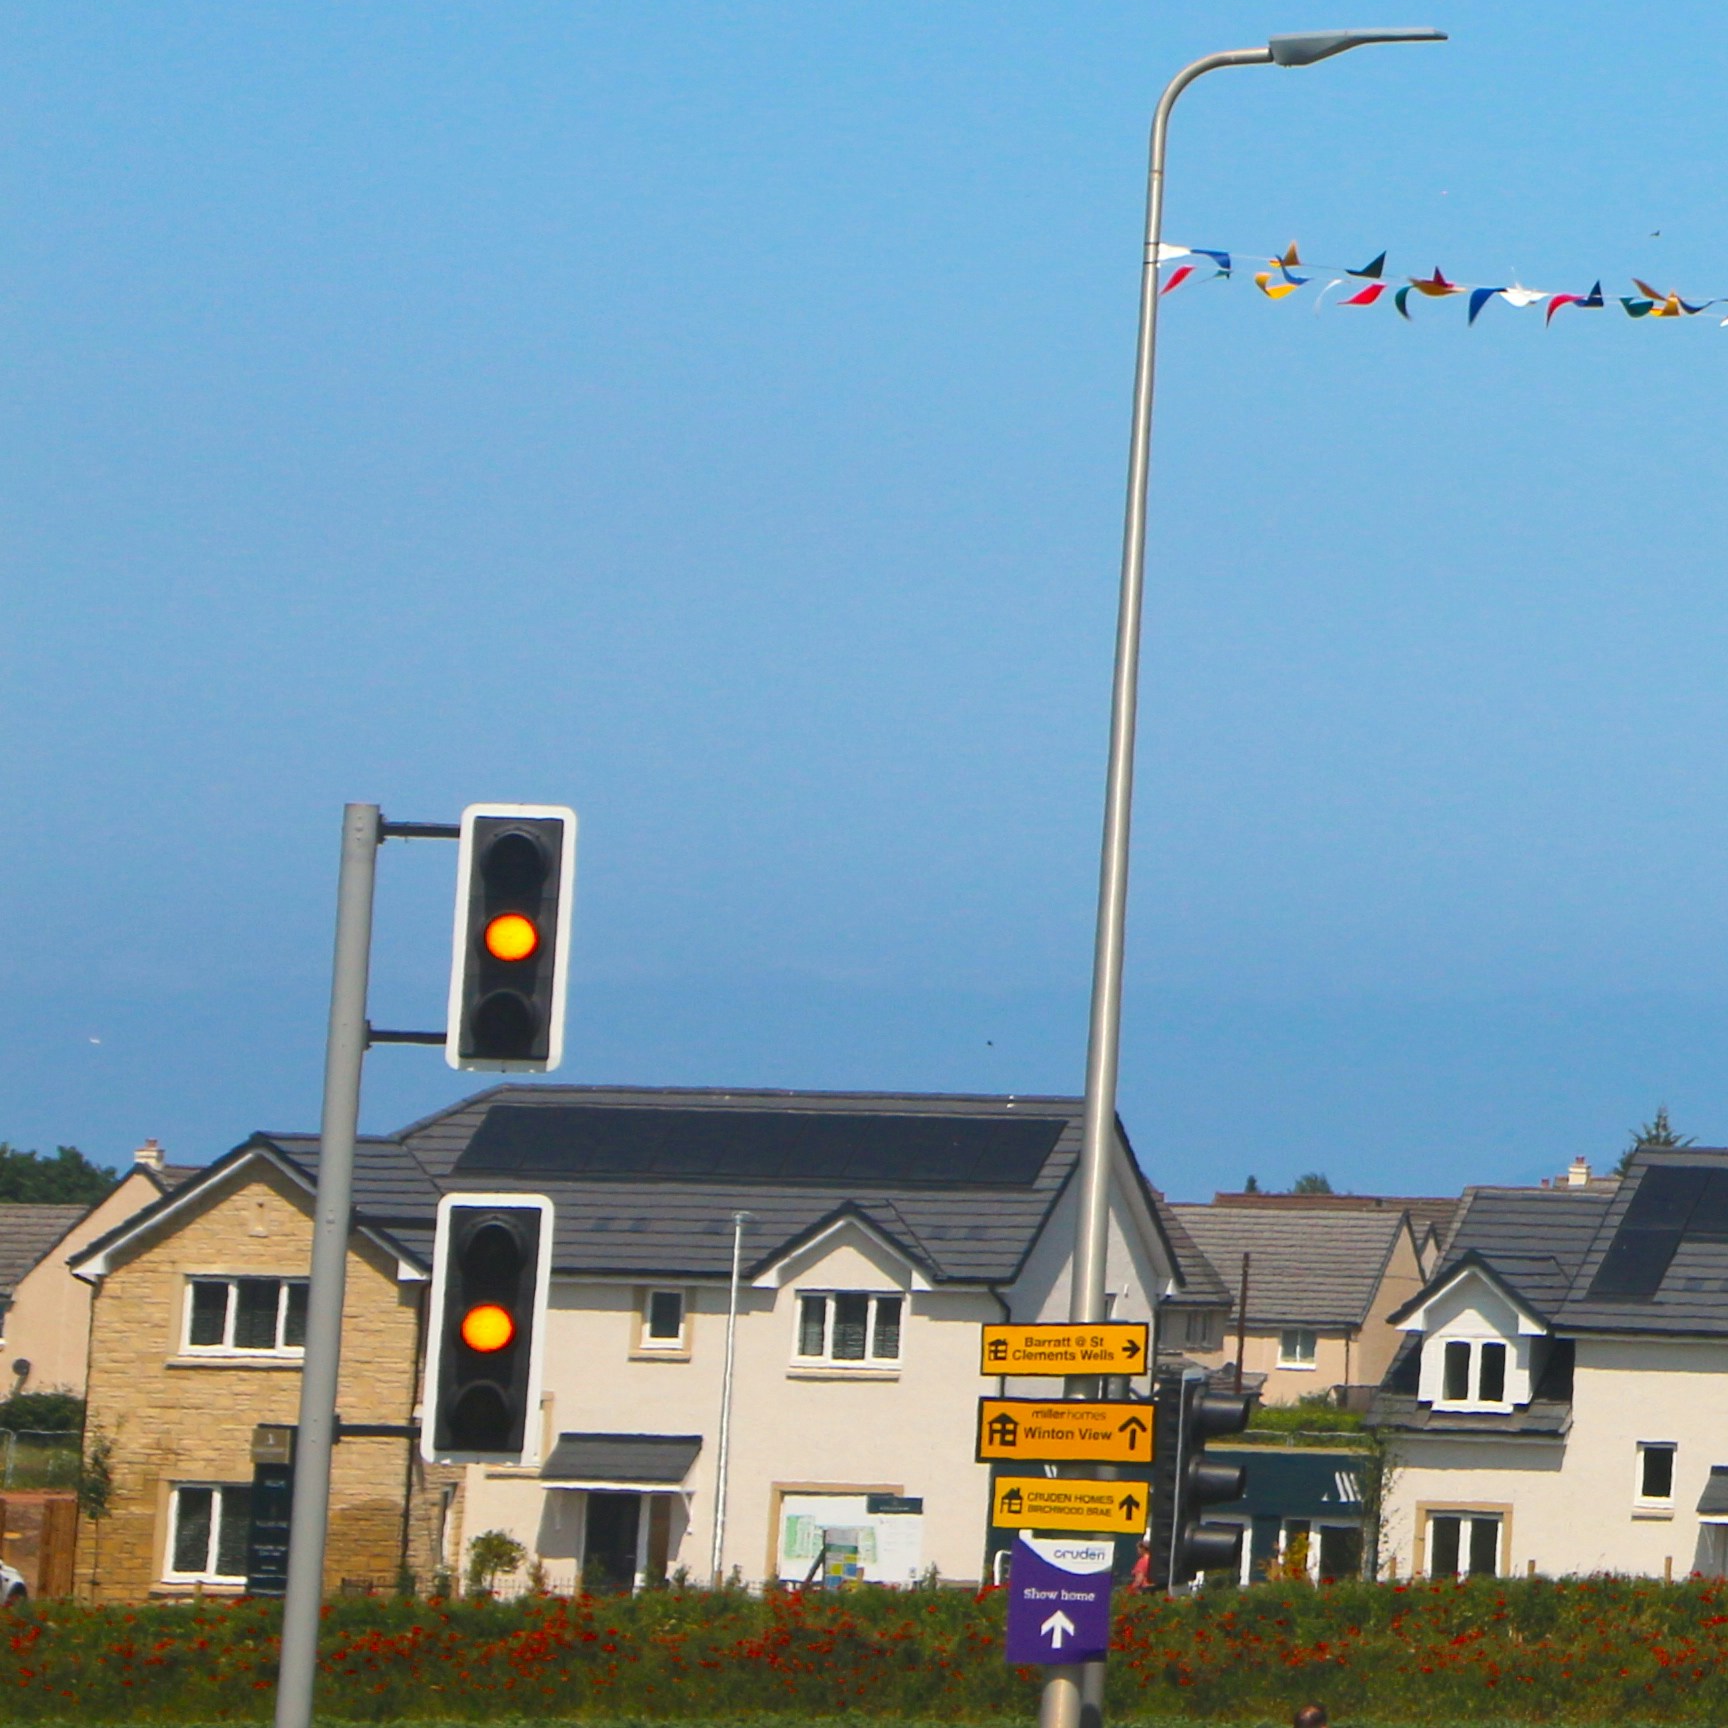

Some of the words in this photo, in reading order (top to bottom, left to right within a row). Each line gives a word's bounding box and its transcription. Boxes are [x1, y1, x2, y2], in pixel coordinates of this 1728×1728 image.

[1024, 1336, 1071, 1348] Barratt
[1090, 1336, 1104, 1348] St
[1012, 1350, 1076, 1361] Clements
[1080, 1350, 1115, 1361] Wells
[1023, 1426, 1075, 1441] Winton
[1078, 1428, 1113, 1441] View
[1027, 1491, 1072, 1503] CRUDEN
[1074, 1493, 1114, 1505] HOMES
[1086, 1506, 1113, 1517] BRAE
[1053, 1547, 1105, 1561] cruden
[1023, 1587, 1058, 1600] Show
[1060, 1588, 1096, 1602] home
